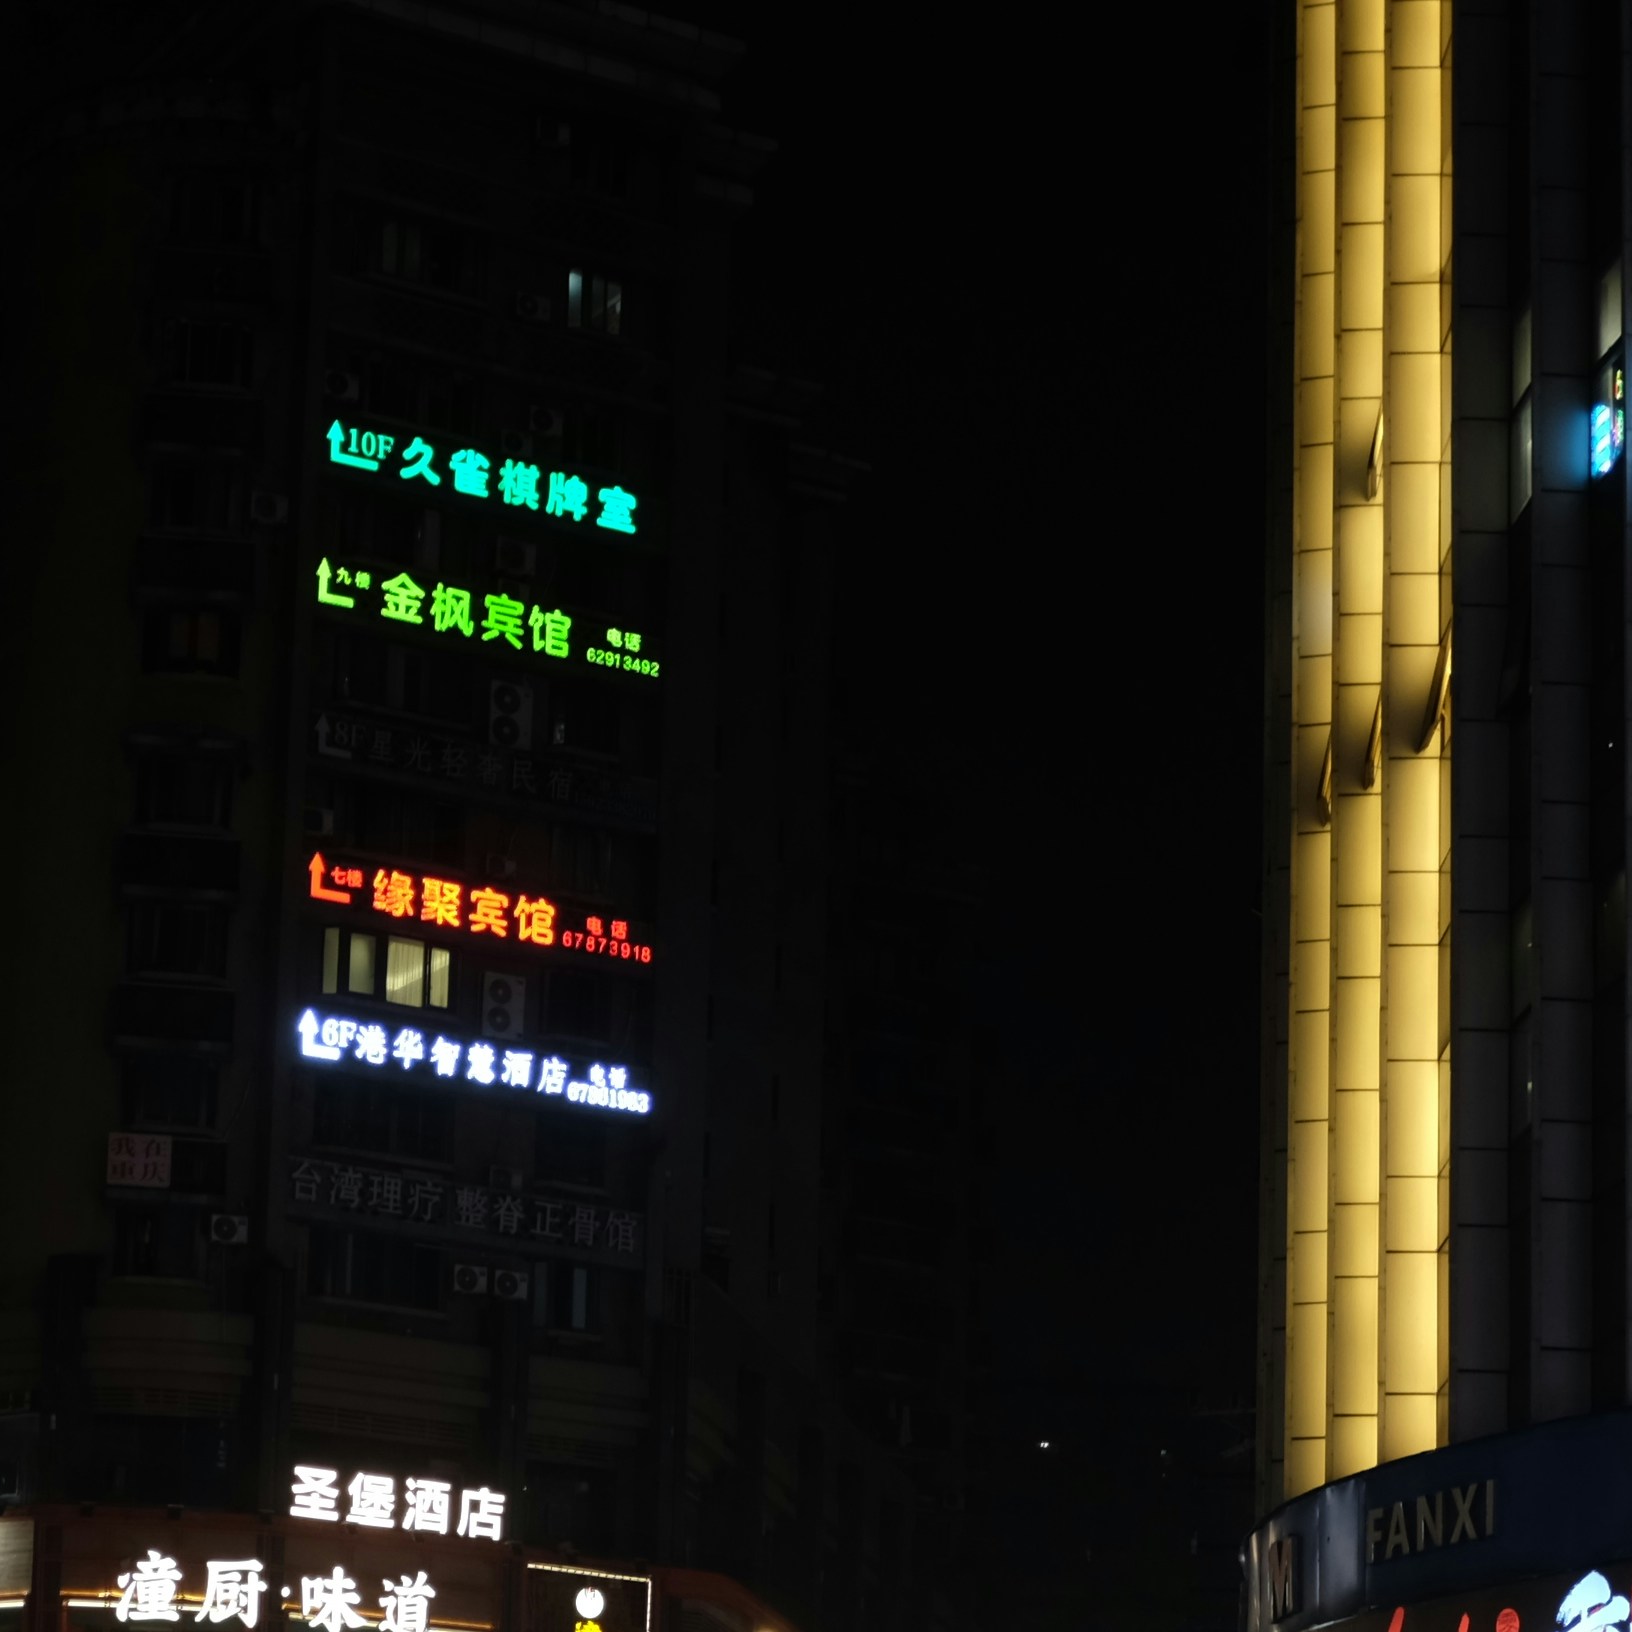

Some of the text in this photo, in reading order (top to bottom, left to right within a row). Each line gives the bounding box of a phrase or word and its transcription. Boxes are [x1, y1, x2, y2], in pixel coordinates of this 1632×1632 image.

[348, 428, 637, 534] 10F 久雀棋牌室
[336, 566, 642, 658] 九楼 金枫宾馆 电话
[586, 647, 660, 678] 62913492
[334, 720, 366, 748] 8F
[372, 730, 574, 801] 星光轻奢民宿
[330, 866, 628, 946] 七楼 缘聚宾馆 电话
[562, 930, 652, 964] 67873918
[321, 1018, 358, 1048] 6F
[355, 1024, 568, 1095] 港华智慧酒店
[291, 1158, 639, 1255] 台湾理疗 整脊正骨馆
[291, 1466, 506, 1541] 圣堡酒店
[1368, 1478, 1499, 1565] FANXI
